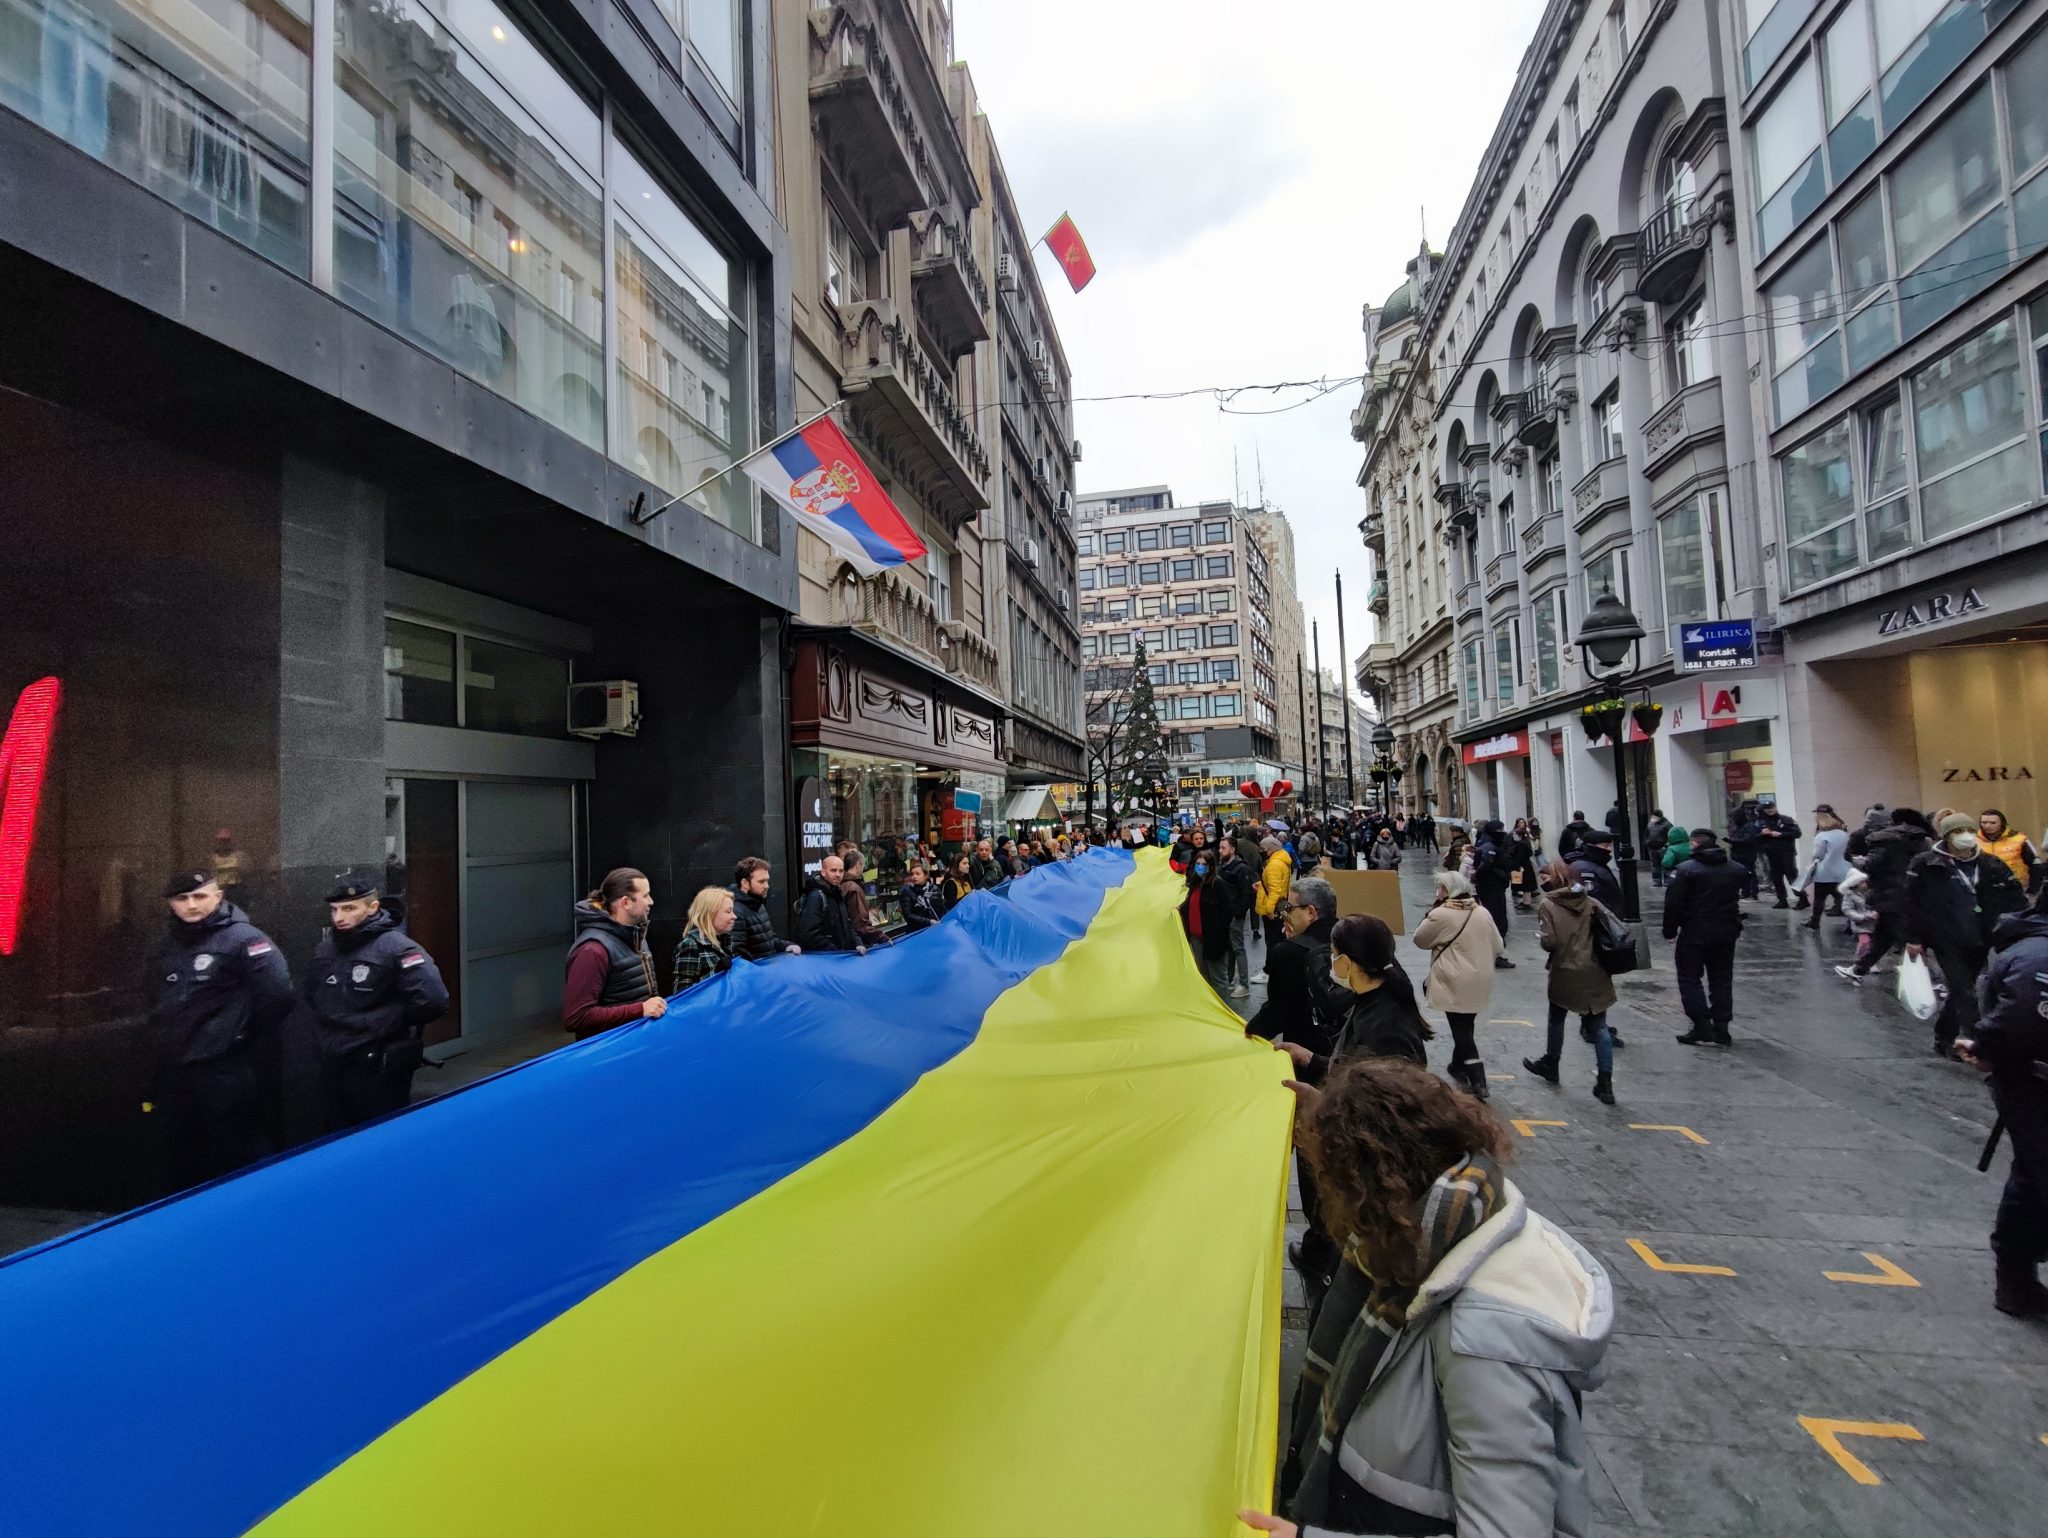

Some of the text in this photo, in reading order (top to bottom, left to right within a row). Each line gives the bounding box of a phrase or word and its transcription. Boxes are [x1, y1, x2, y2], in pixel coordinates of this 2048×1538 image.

[1878, 585, 1988, 636] ZARA
[1705, 628, 1751, 639] ILIRIKA
[1698, 648, 1737, 658] Kontakt
[1711, 685, 1741, 715] A1
[1673, 706, 1682, 728] A1
[1181, 777, 1233, 788] BELGRADE
[1942, 766, 2033, 783] ZARA
